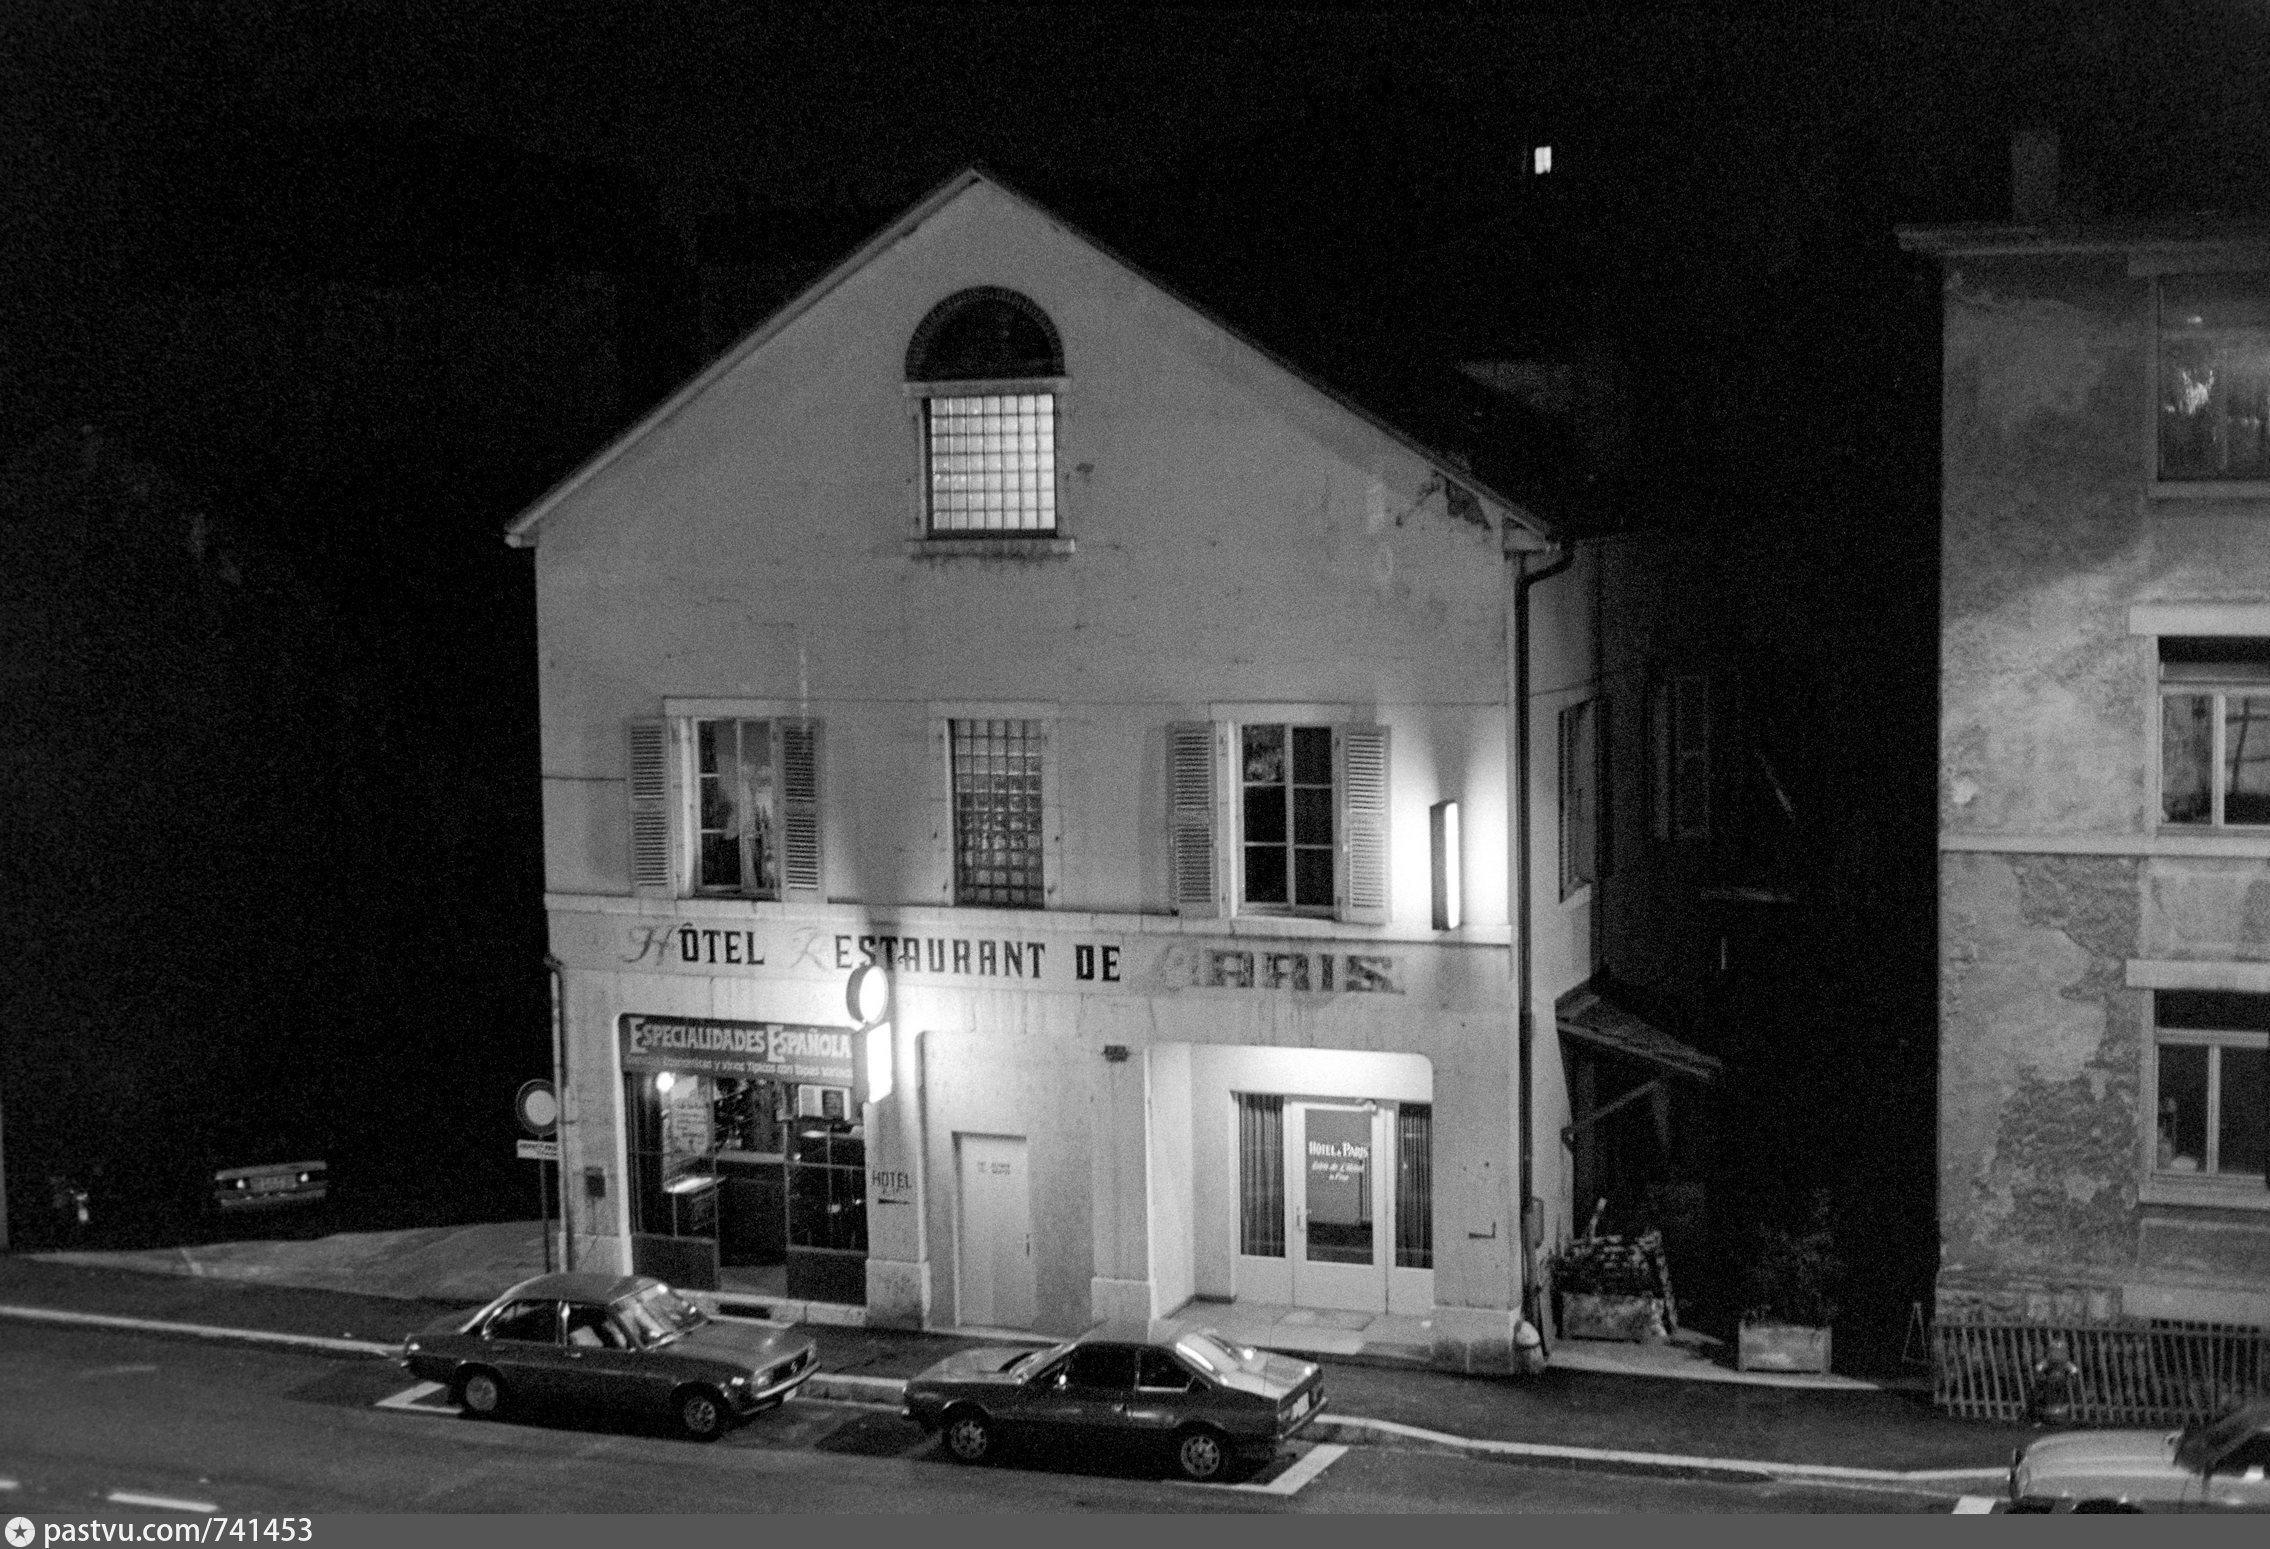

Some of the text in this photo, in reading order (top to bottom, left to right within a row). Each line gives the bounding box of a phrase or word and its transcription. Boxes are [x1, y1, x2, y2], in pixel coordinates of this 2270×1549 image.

[619, 922, 766, 966] HÔTEL
[788, 925, 1046, 979] RESTAURANT
[1074, 943, 1121, 982] DE
[628, 1017, 766, 1054] ESPECIALIDADES
[871, 1169, 912, 1190] HOTEL
